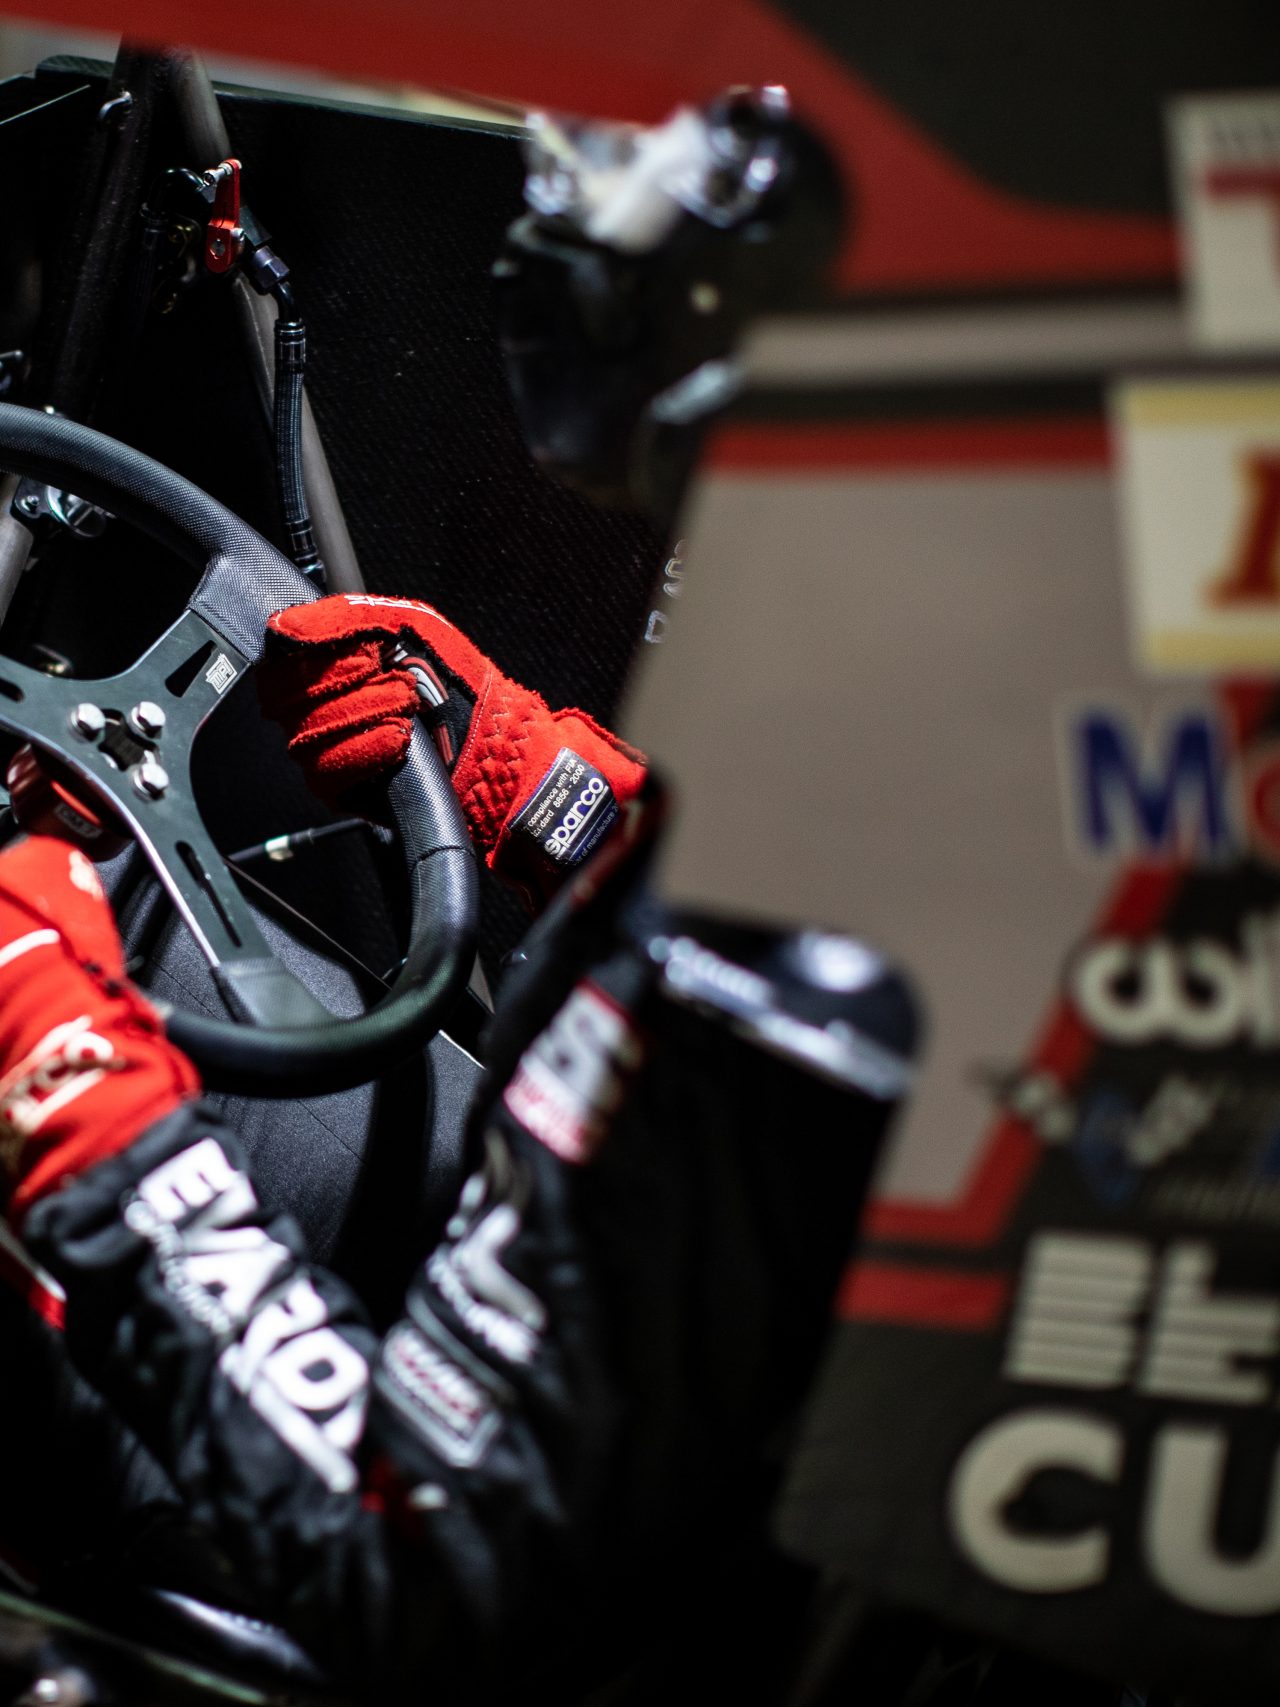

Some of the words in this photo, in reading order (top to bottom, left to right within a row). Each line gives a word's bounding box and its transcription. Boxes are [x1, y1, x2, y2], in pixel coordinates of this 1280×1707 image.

[528, 788, 558, 827] compliance
[556, 772, 568, 790] with
[569, 763, 586, 785] 2000
[544, 777, 604, 856] sparco
